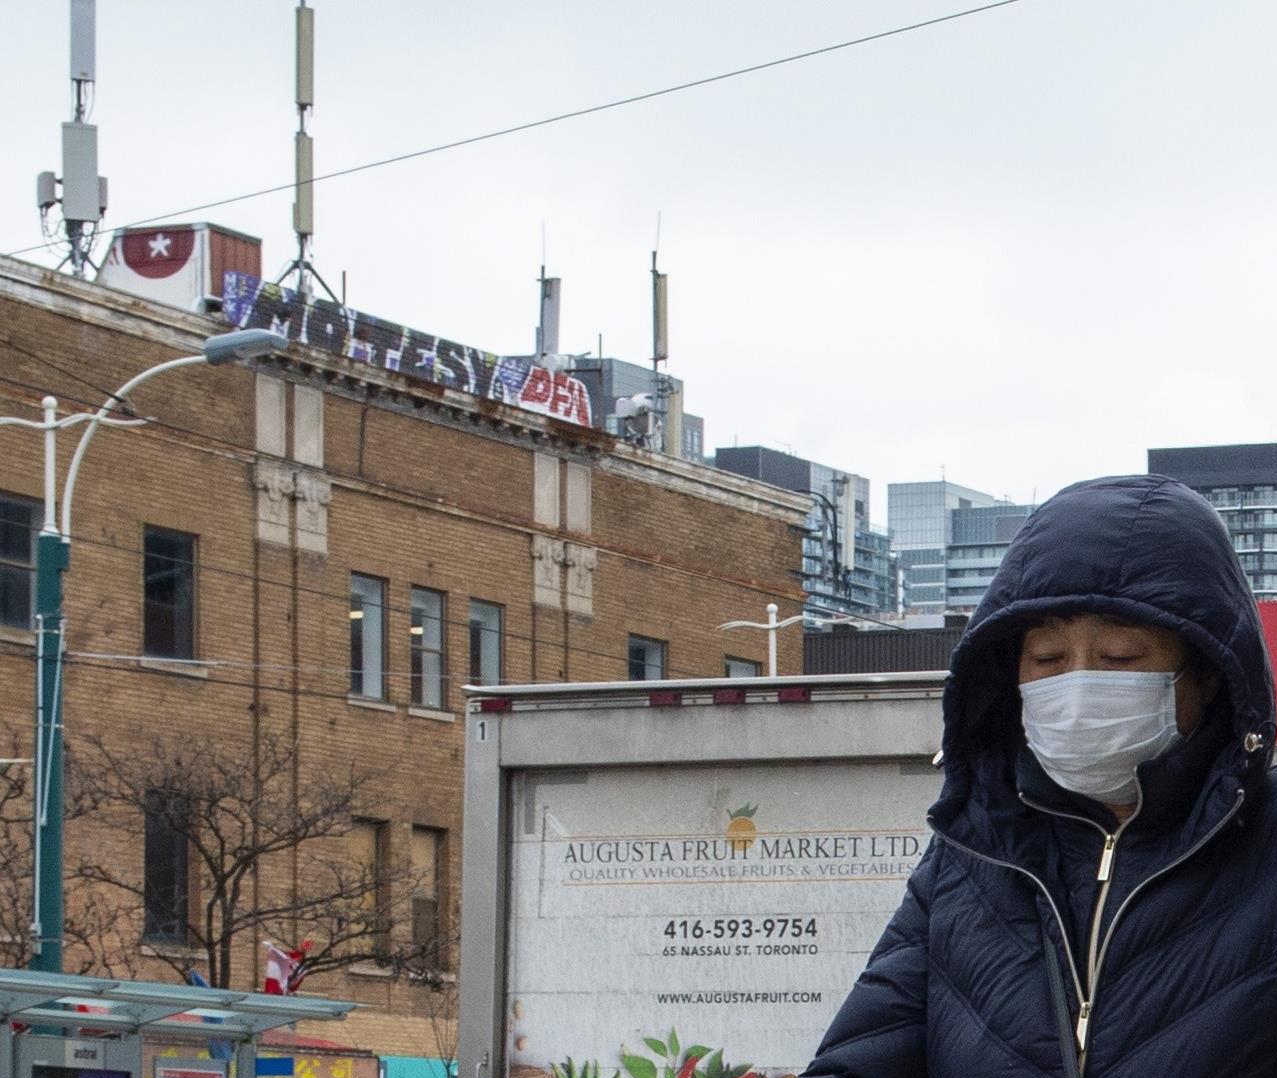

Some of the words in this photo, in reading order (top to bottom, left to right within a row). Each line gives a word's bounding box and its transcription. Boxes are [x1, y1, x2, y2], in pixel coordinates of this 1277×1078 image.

[479, 721, 486, 741] 1
[564, 840, 675, 864] AUGUSTA
[681, 838, 752, 862] FRUIT
[760, 836, 863, 860] MARKET
[870, 835, 923, 858] LTD.
[569, 867, 637, 882] QUALITY
[643, 865, 736, 880] WHOLESALE
[742, 863, 794, 878] FRUITS
[802, 865, 811, 877] &
[818, 861, 915, 876] VEGETABLES
[664, 918, 819, 940] 416-593-9754
[662, 946, 677, 958] 65
[681, 945, 731, 957] NASSAU
[736, 945, 752, 956] ST.
[756, 943, 819, 956] TORONTO
[657, 991, 823, 1005] WWW.AUGUSTAFRUIT.COM
[74, 1048, 98, 1060] astral
